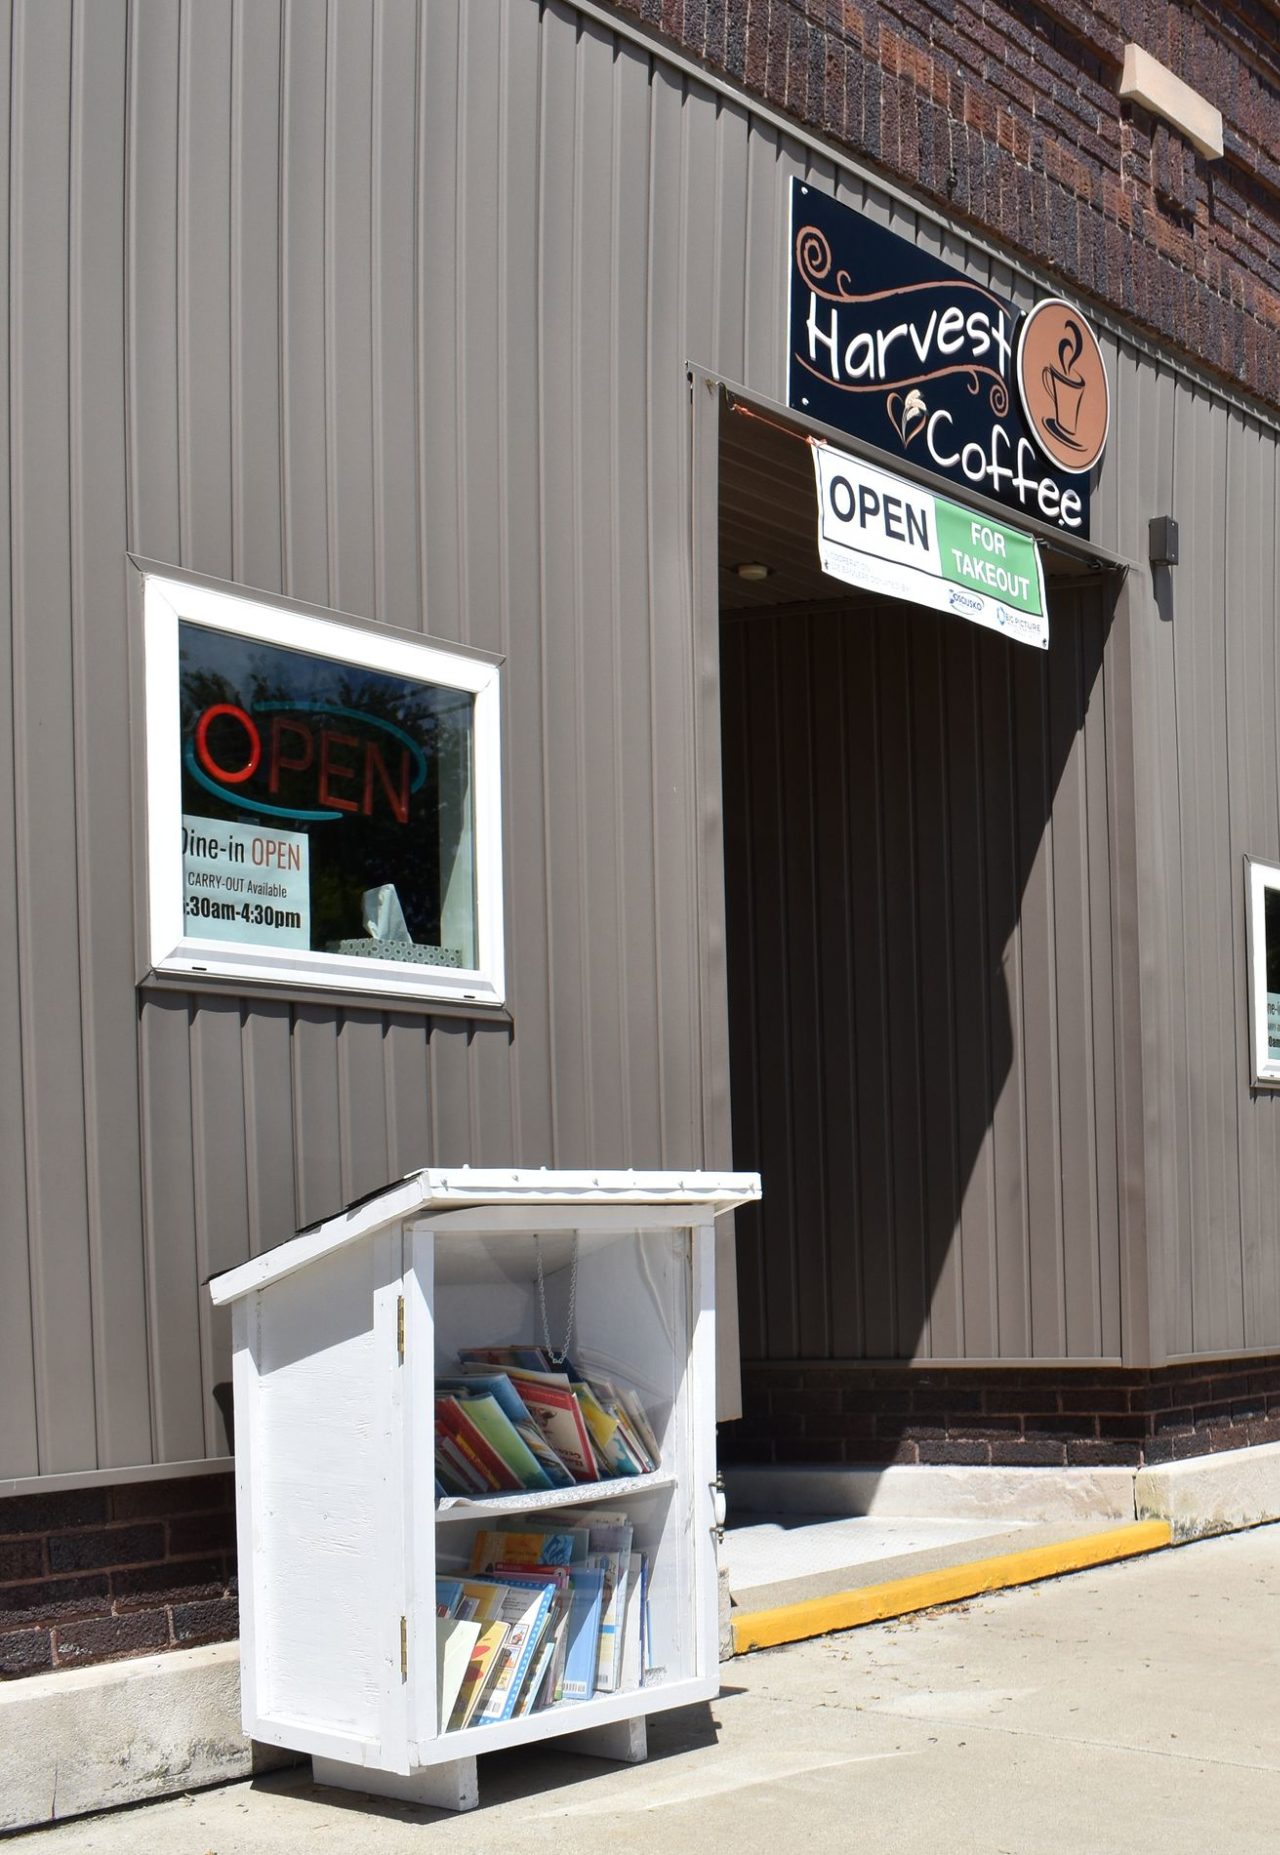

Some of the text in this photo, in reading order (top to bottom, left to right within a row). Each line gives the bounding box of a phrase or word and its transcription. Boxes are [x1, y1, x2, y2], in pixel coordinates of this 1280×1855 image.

[806, 291, 1012, 380] Harvest
[926, 409, 1082, 527] Coffee
[829, 475, 930, 552] OPEN
[971, 522, 1006, 558] FOR
[951, 549, 1030, 600] TAKEOUT
[195, 704, 409, 823] OPEN
[251, 837, 301, 872] OPEN
[187, 871, 287, 898] CARRY-OUT Available
[182, 895, 301, 928] :30am-4:30pm
